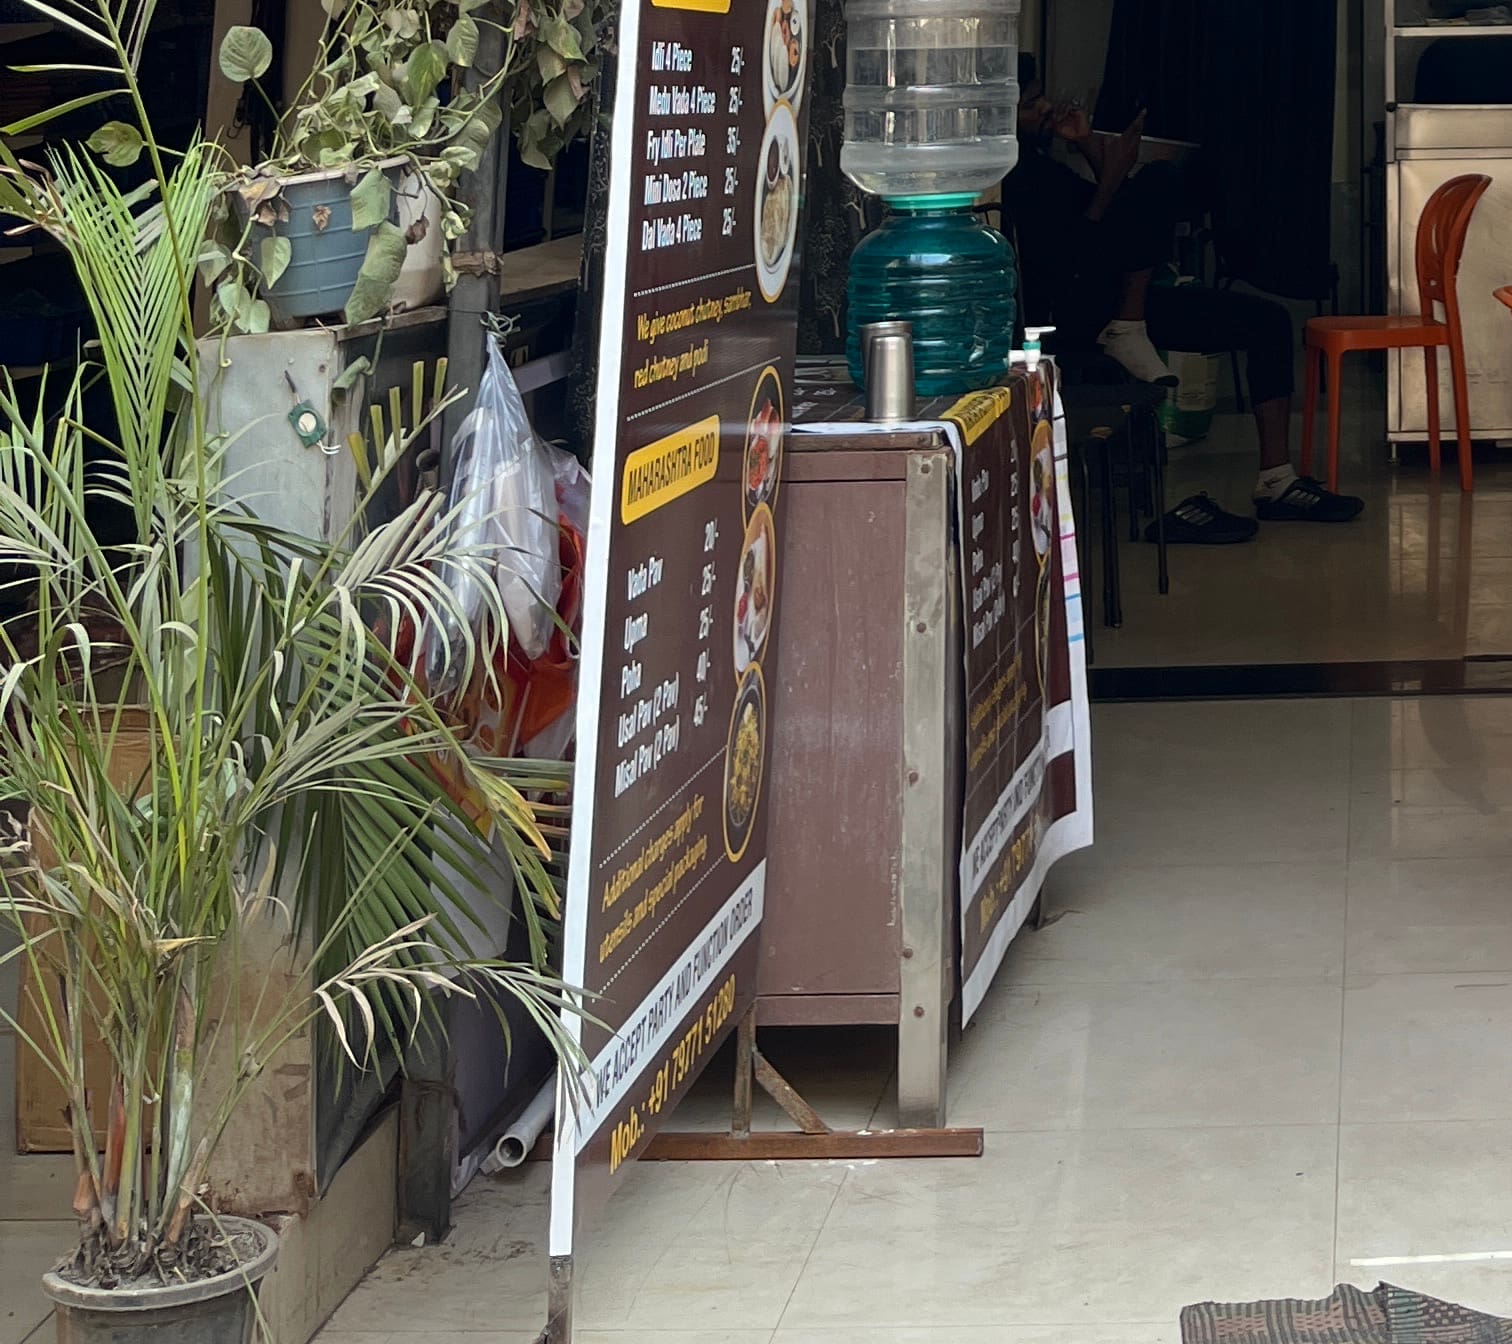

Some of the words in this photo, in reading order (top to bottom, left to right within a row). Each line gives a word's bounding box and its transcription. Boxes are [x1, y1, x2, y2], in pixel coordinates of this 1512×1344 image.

[665, 43, 671, 68] 4
[672, 43, 693, 72] Piece
[649, 86, 671, 116] Medu
[671, 86, 689, 115] Vada
[697, 86, 716, 115] Piece
[647, 129, 661, 166] Fry
[687, 128, 706, 157] Plate
[644, 174, 662, 206] Mini
[662, 174, 681, 203] Dosa
[681, 174, 687, 199] 2
[689, 172, 708, 199] Piece
[641, 220, 656, 251] Dal
[656, 217, 675, 249] Vada
[676, 216, 681, 244] 4
[682, 216, 702, 242] Piece
[637, 312, 649, 341] We
[649, 311, 665, 344] give
[666, 303, 695, 332] coconut
[634, 358, 649, 389] red
[649, 355, 679, 381] chutney
[679, 343, 693, 372] and
[692, 339, 709, 377] podi
[628, 443, 692, 506] MAHARASHTRA
[694, 431, 715, 473] FOOD
[628, 561, 648, 602] Vada
[648, 555, 664, 590] Pav
[624, 610, 648, 655] Upma
[601, 847, 646, 914] Additional
[645, 827, 674, 874] charges
[674, 812, 693, 848] apply
[693, 794, 704, 824] for
[598, 905, 633, 964] utensils
[633, 887, 648, 927] and
[648, 862, 673, 919] special
[596, 1066, 611, 1110] WE
[612, 1015, 648, 1087] ACCEPT
[647, 985, 675, 1045] PARTY
[674, 961, 692, 1008] AND
[693, 919, 729, 996] FUNCTION
[729, 887, 753, 944] ORDER
[648, 1059, 669, 1116] +91
[672, 1019, 703, 1092] 79771
